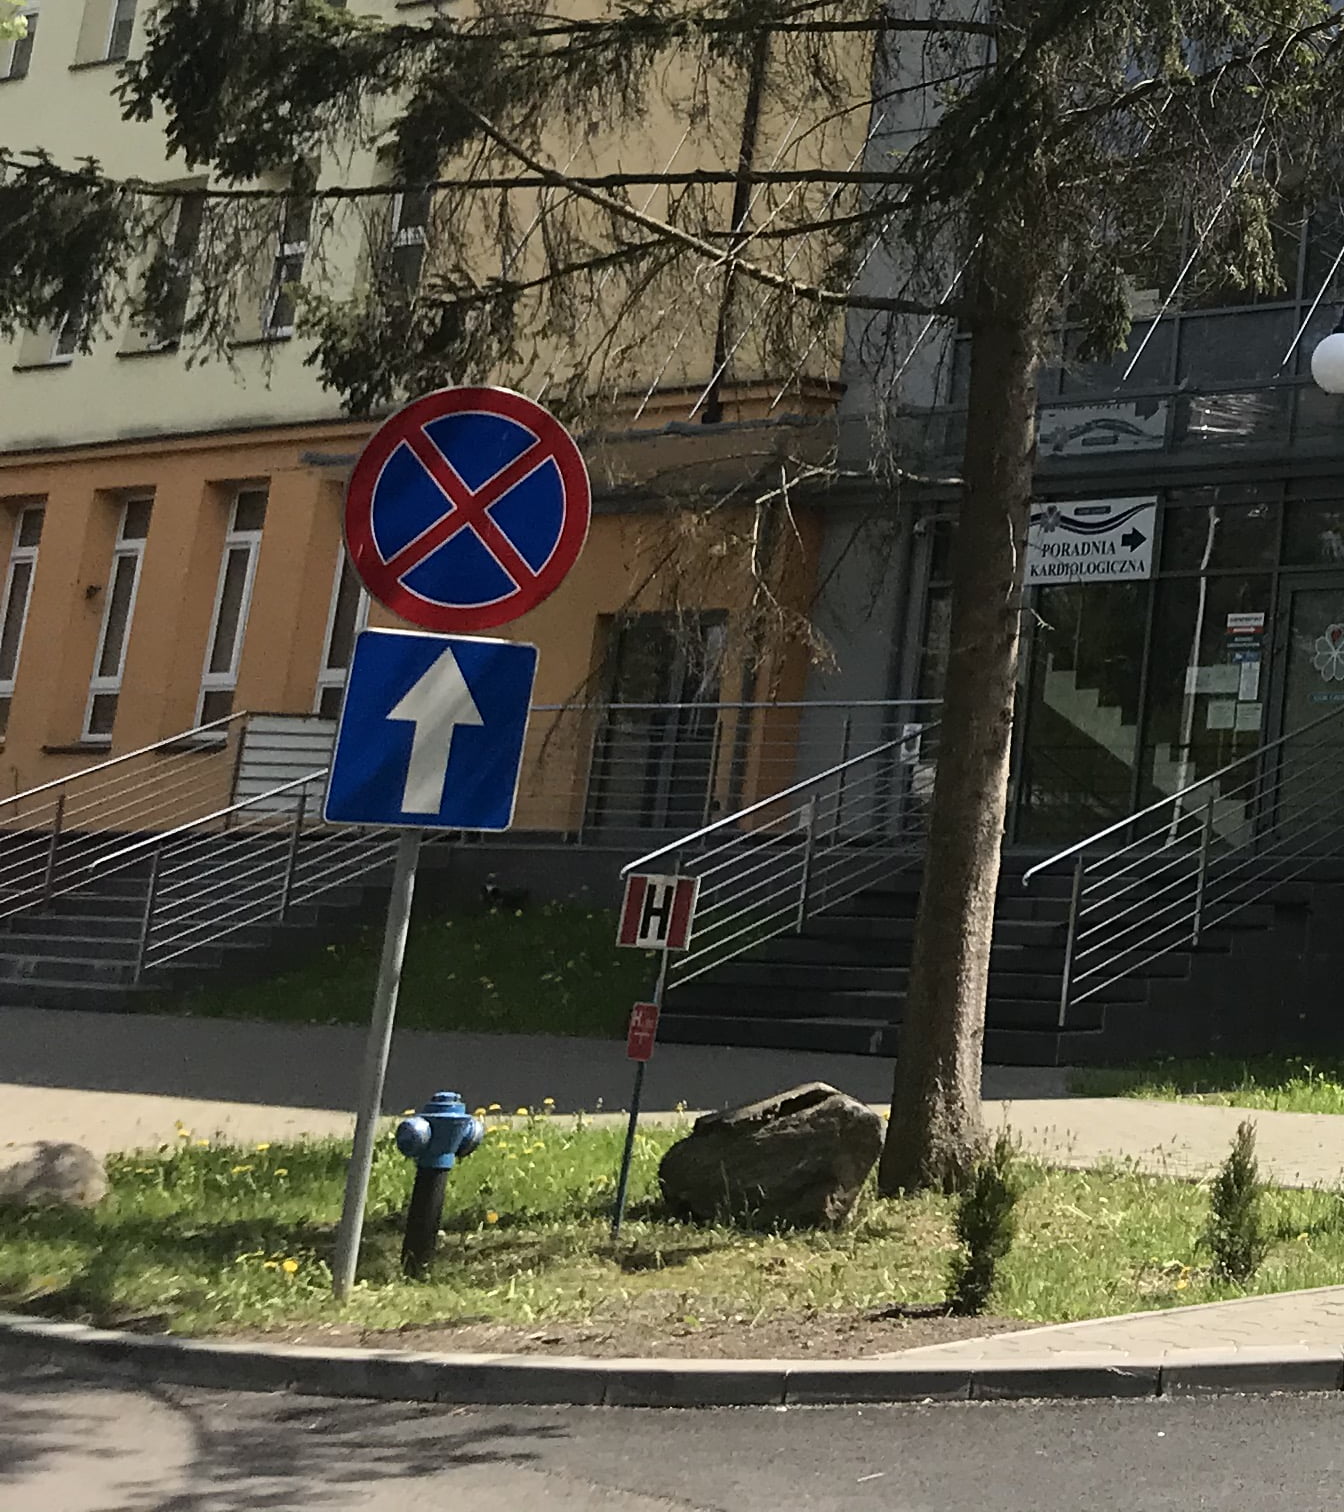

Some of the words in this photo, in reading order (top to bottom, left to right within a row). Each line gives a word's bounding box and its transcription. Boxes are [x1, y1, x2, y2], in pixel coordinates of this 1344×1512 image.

[1041, 540, 1116, 558] PORADNIA
[1030, 559, 1145, 577] KARDIOLOGICZNA
[639, 883, 675, 941] H
